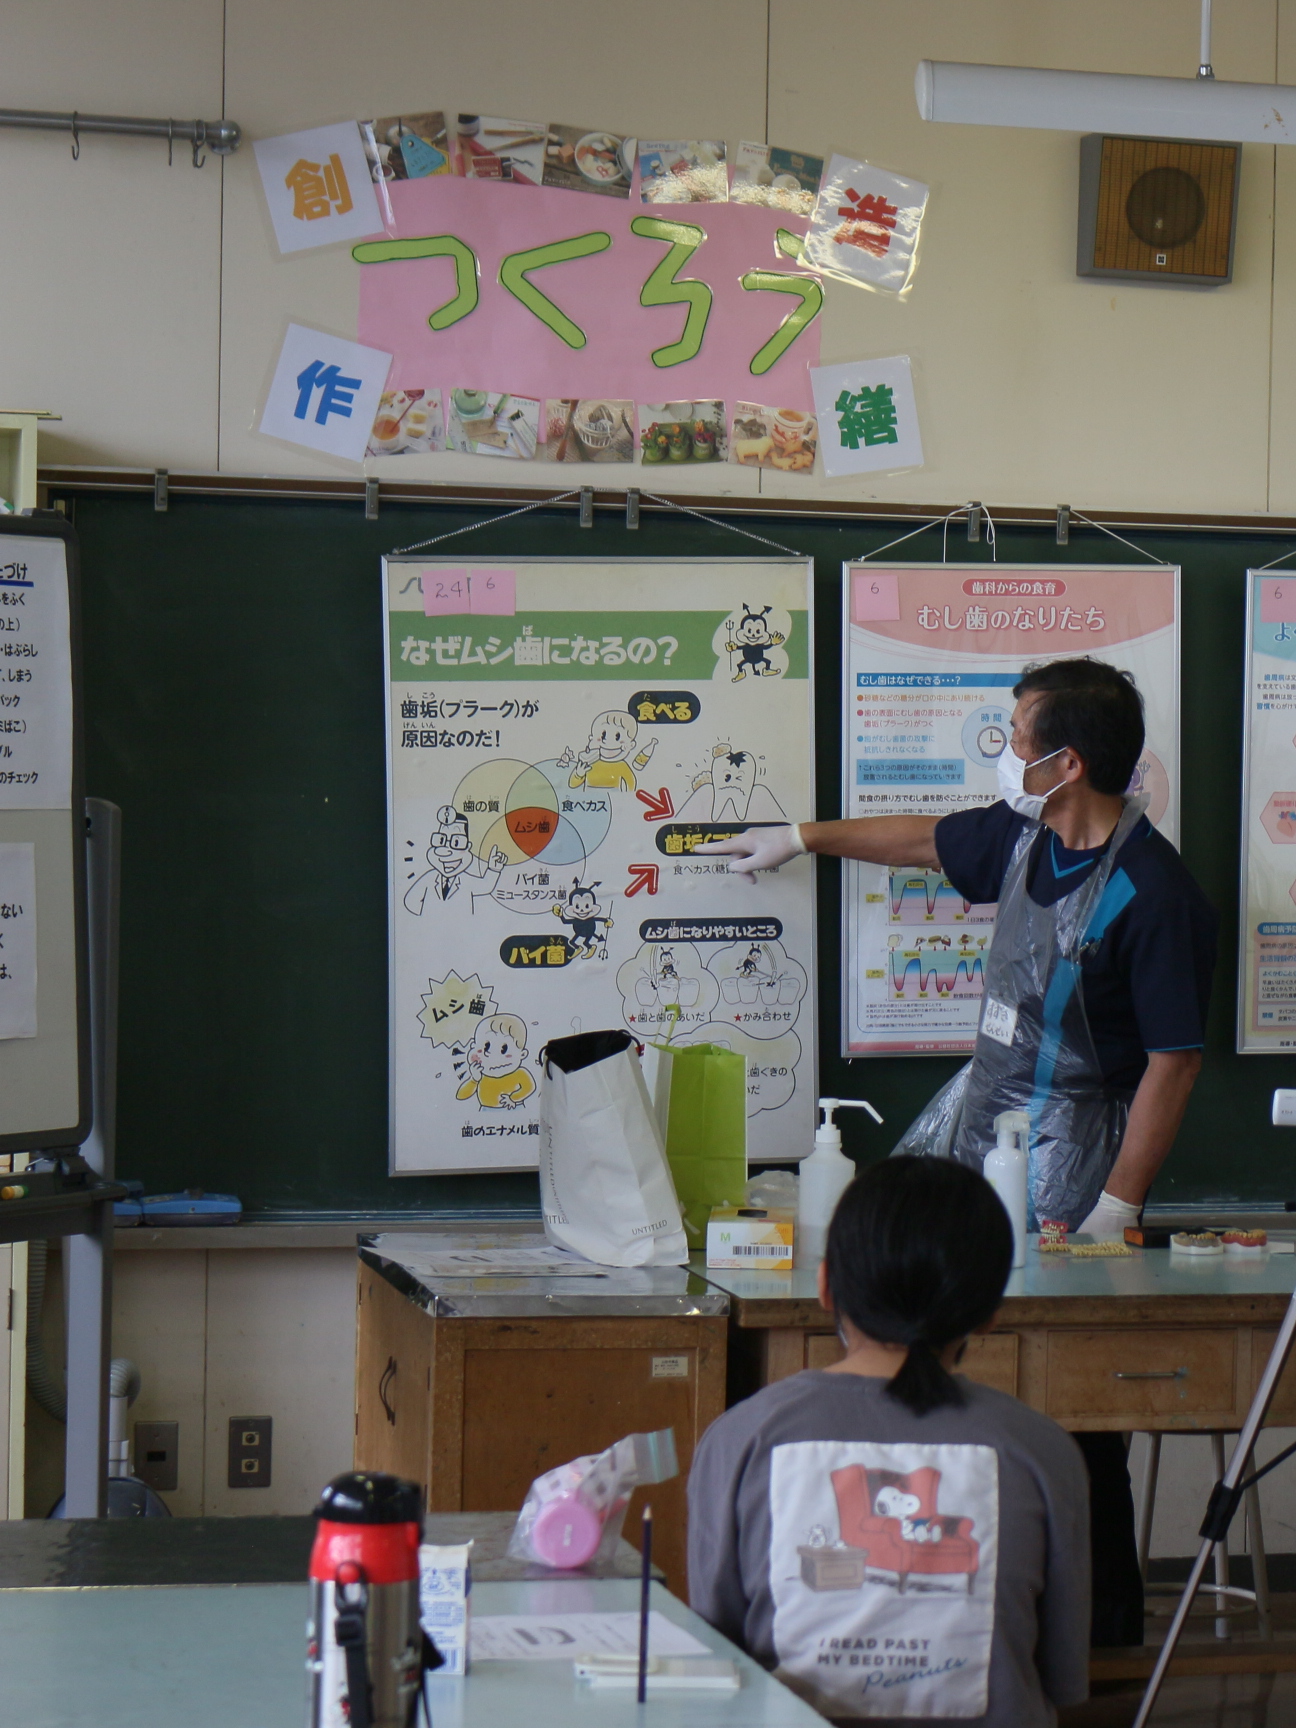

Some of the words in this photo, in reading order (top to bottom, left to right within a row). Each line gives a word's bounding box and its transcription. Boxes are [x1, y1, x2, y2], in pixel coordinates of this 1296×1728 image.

[285, 152, 354, 222] 創
[352, 216, 824, 375] つくろう
[294, 359, 362, 426] 作
[834, 382, 899, 450] 繕
[435, 581, 464, 600] 24
[486, 576, 496, 590] 6
[870, 582, 880, 594] 6
[971, 581, 1056, 595] 歯科からの食育
[1274, 586, 1282, 600] 6
[917, 604, 1106, 632] むし歯のなりたち
[400, 635, 679, 666] なぜムシ歯になるの?
[0, 668, 32, 682] 、しまう
[400, 699, 540, 719] 歯垢(プラーク)が
[636, 702, 692, 722] 食べる
[400, 730, 501, 748] 原因なのだ!
[462, 799, 500, 814] 歯の質
[562, 799, 608, 813] 食べカス
[514, 820, 550, 834] ムシ歯
[515, 872, 550, 886] バイ菌
[496, 888, 568, 900] ミュースタンス菌
[645, 925, 778, 940] ムシ歯になりやすいところ
[508, 944, 566, 965] バイ菌
[432, 998, 486, 1024] ムシ歯
[743, 1010, 792, 1022] かみ合わせ
[461, 1124, 540, 1138] 歯のエナメル質
[632, 1220, 668, 1236] UNTITLED
[720, 1232, 731, 1242] M
[830, 1638, 878, 1649] READ
[884, 1638, 931, 1650] PAST
[818, 1654, 843, 1666] MY
[850, 1654, 929, 1667] BEDTIME
[862, 1656, 968, 1694] Peanuts
